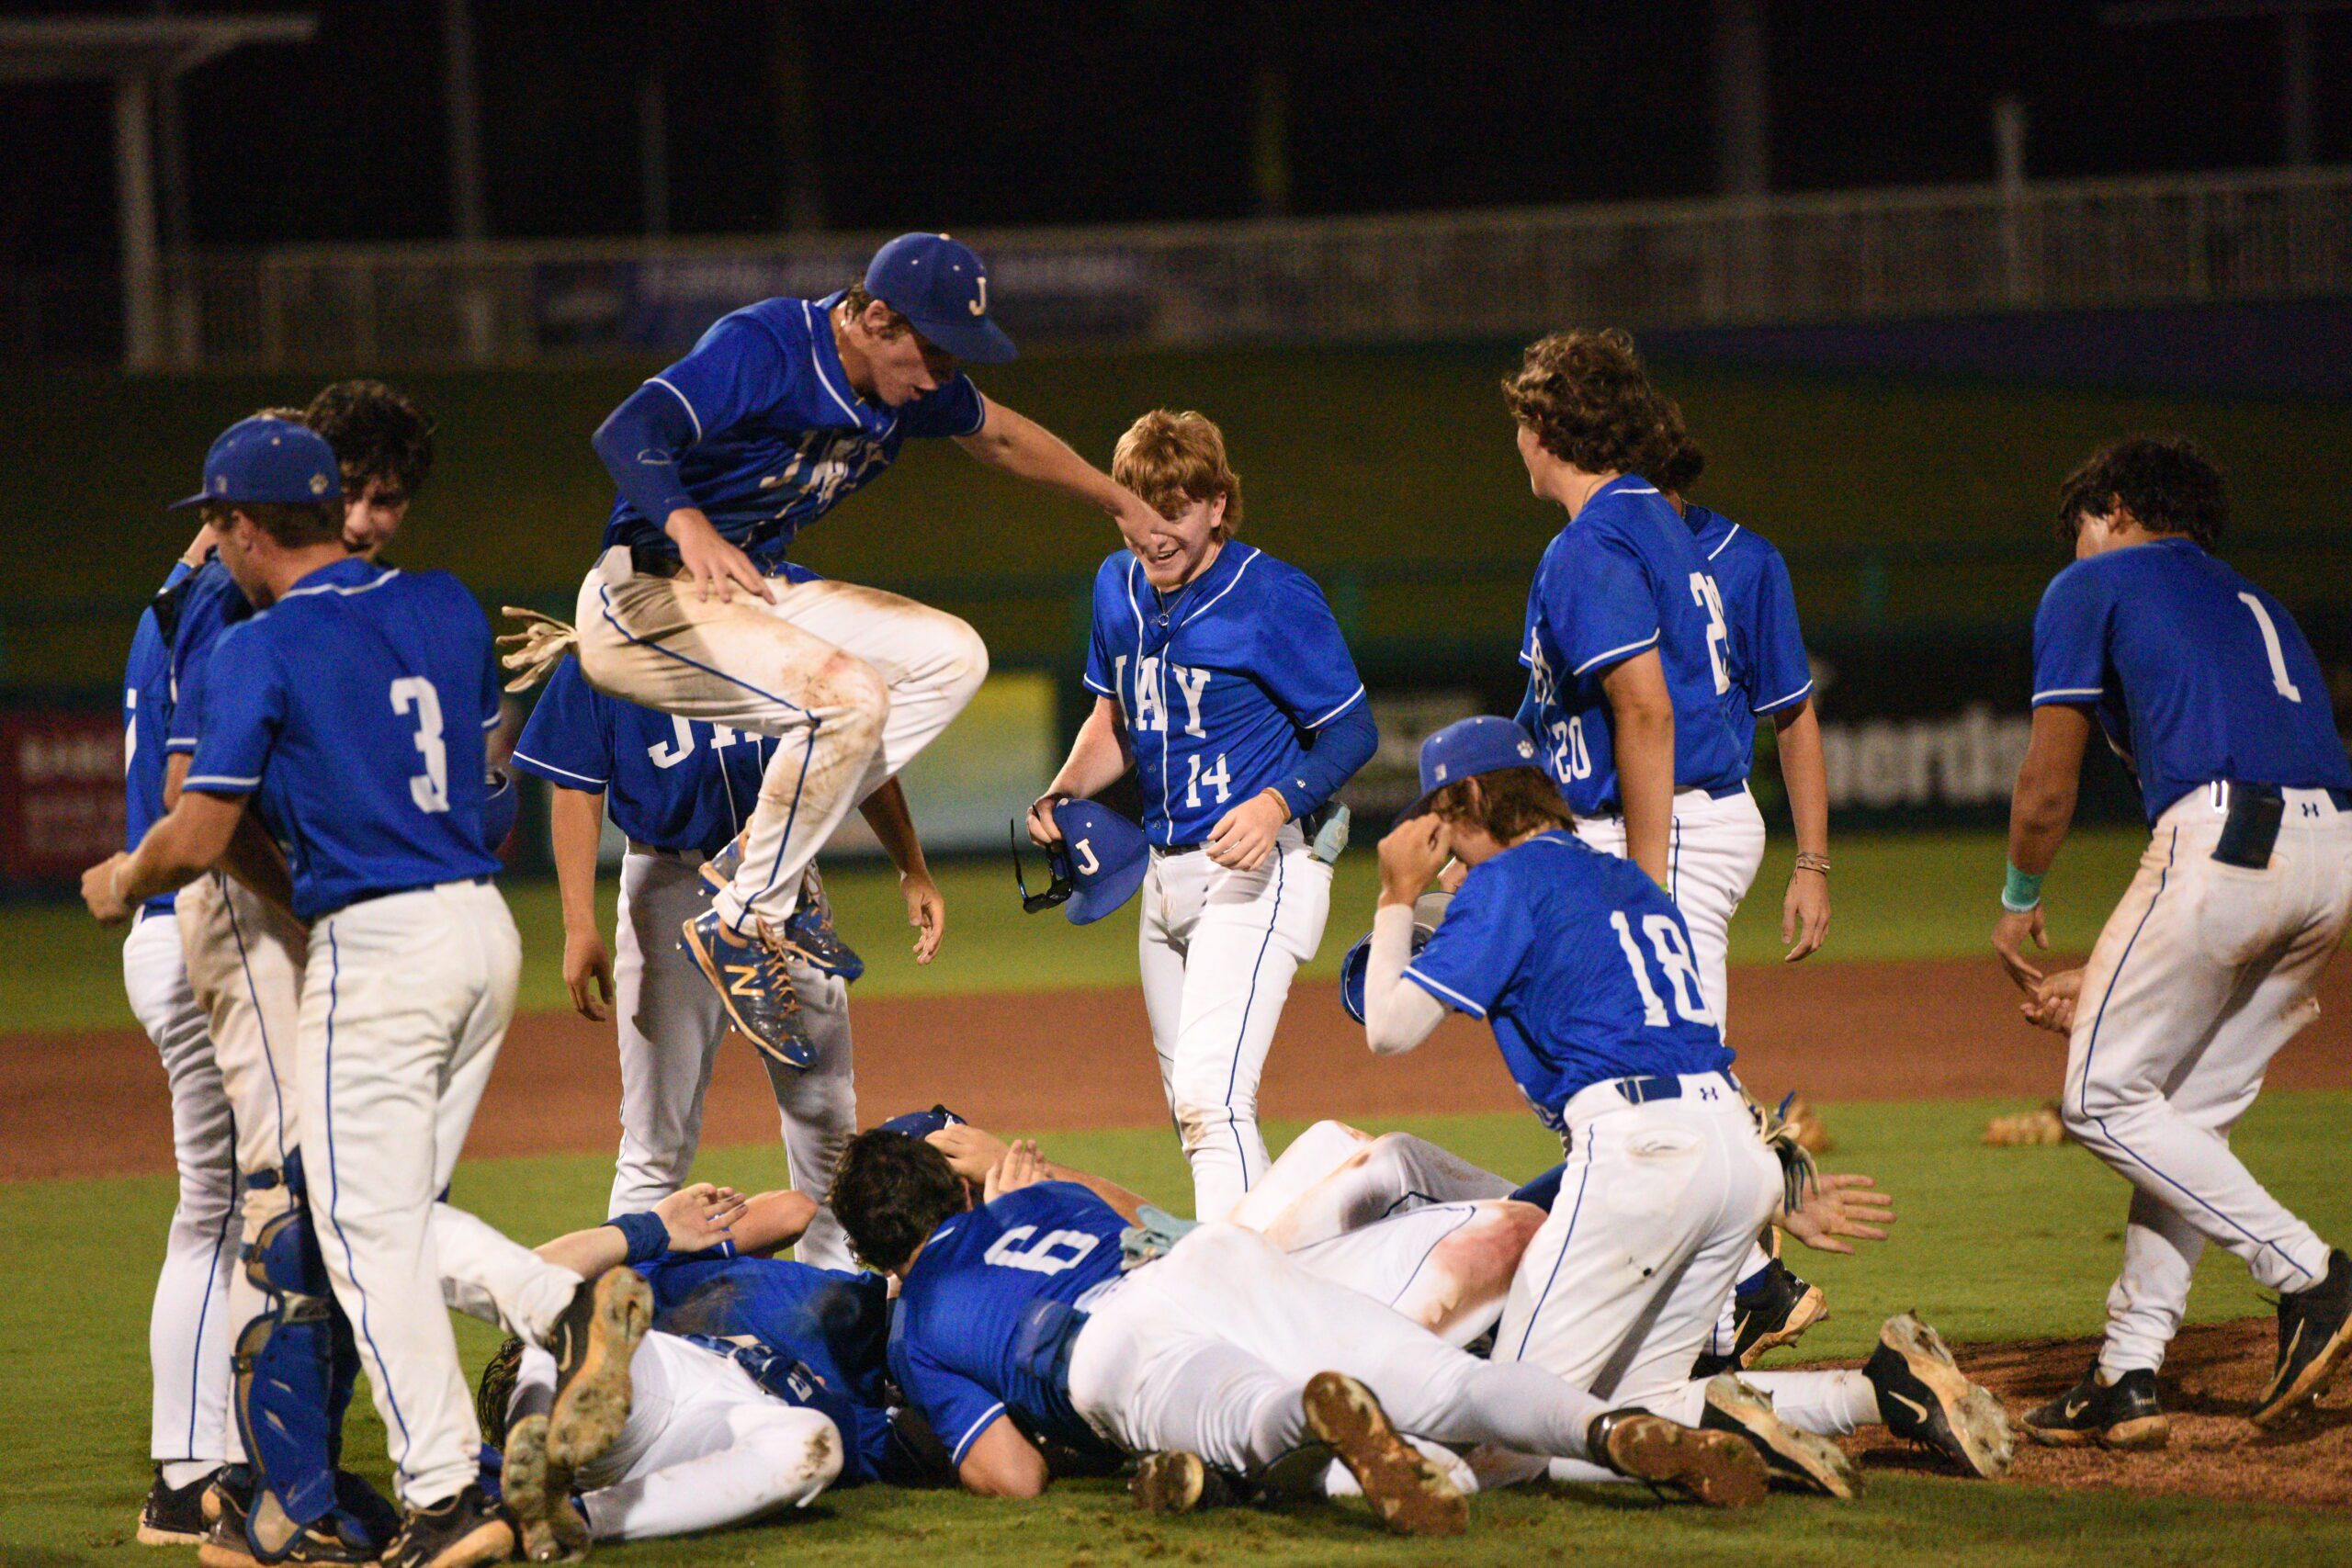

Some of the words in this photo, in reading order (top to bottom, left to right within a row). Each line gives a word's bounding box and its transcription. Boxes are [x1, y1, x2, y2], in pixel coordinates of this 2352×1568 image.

[968, 276, 986, 316] J
[2237, 591, 2301, 704] 1
[390, 675, 450, 814] 3
[1552, 715, 1591, 784] 20
[1185, 752, 1232, 808] 14
[1075, 838, 1100, 876] J
[1610, 910, 1716, 1027] 18
[983, 1224, 1100, 1277] 6
